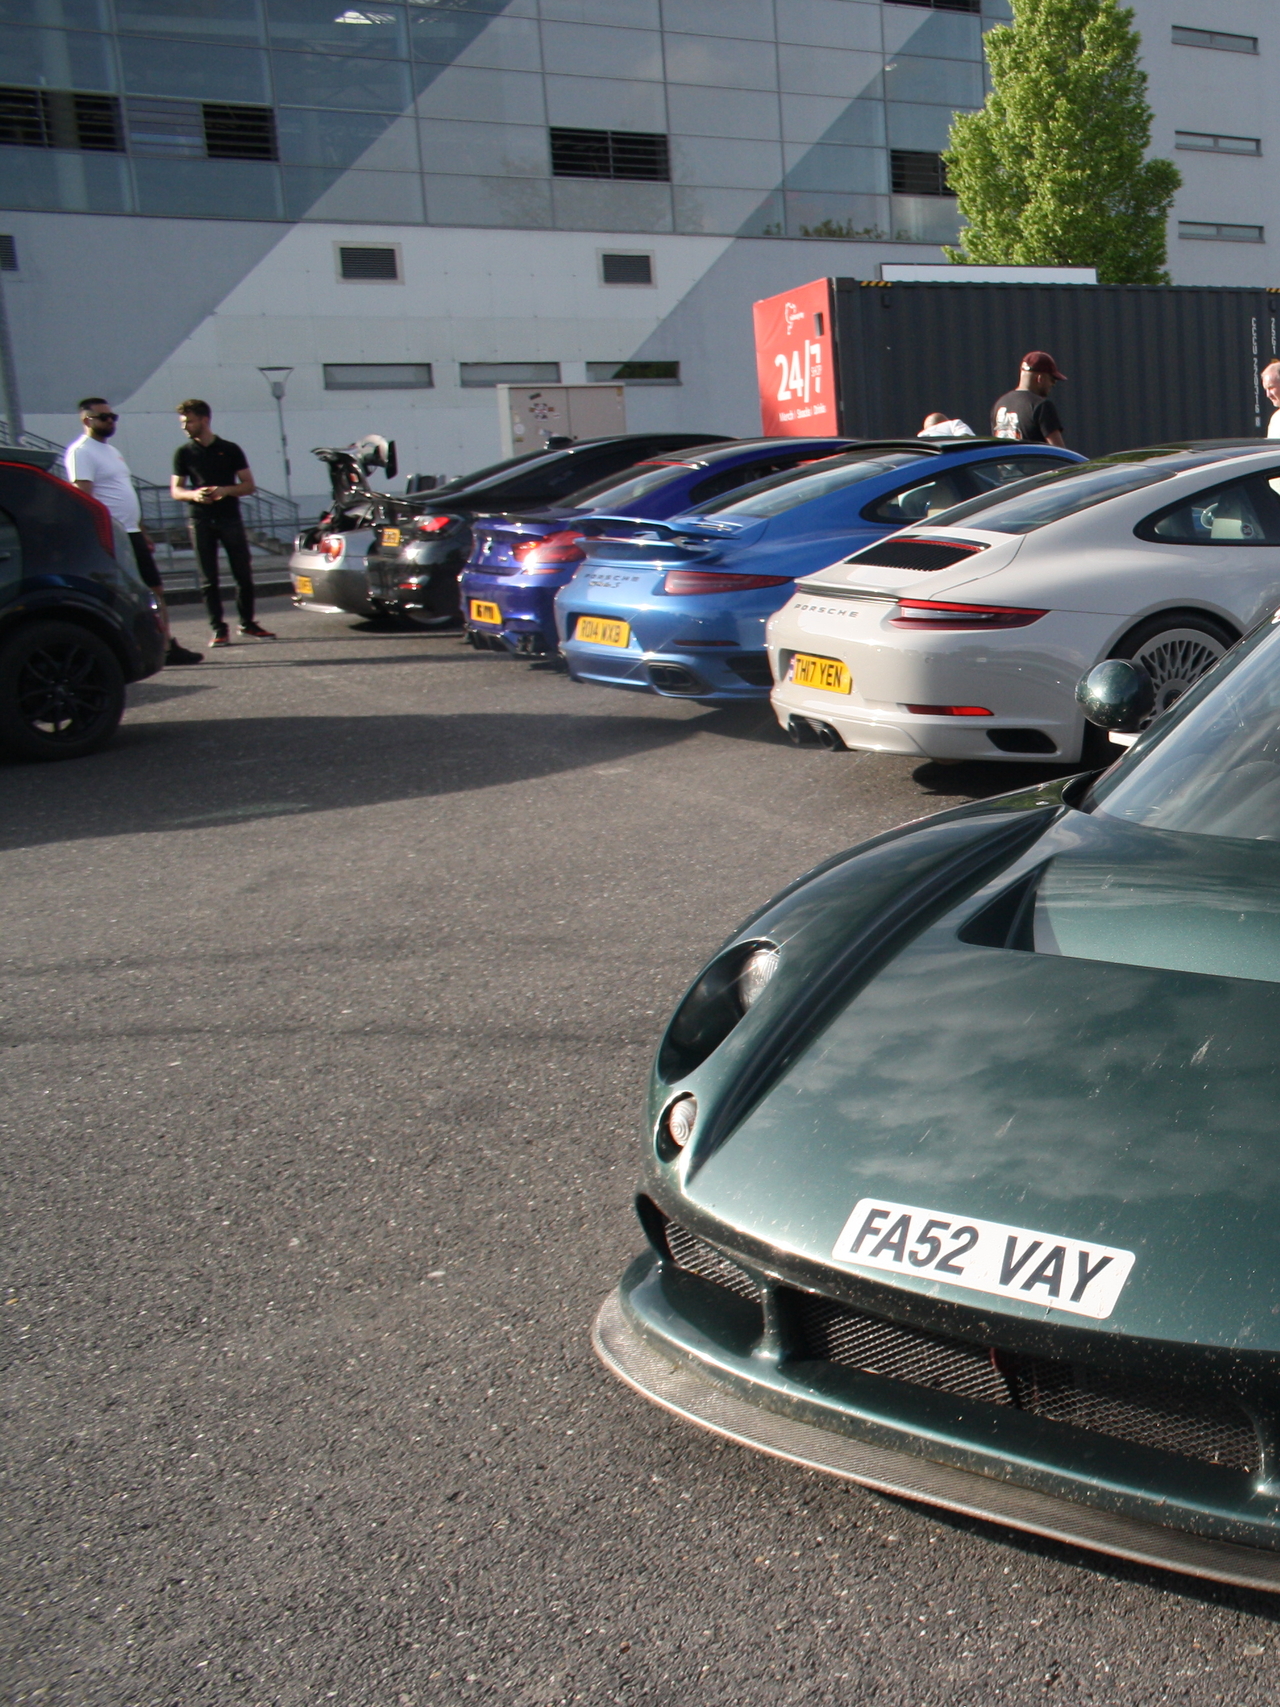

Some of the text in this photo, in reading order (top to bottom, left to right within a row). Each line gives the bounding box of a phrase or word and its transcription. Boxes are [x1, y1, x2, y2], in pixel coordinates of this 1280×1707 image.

[774, 340, 822, 403] 24/7
[584, 573, 640, 582] PORSCHE
[794, 603, 859, 618] PORSCHE
[795, 658, 843, 688] TH17 YEN
[849, 1208, 1115, 1303] FA52 VAY
